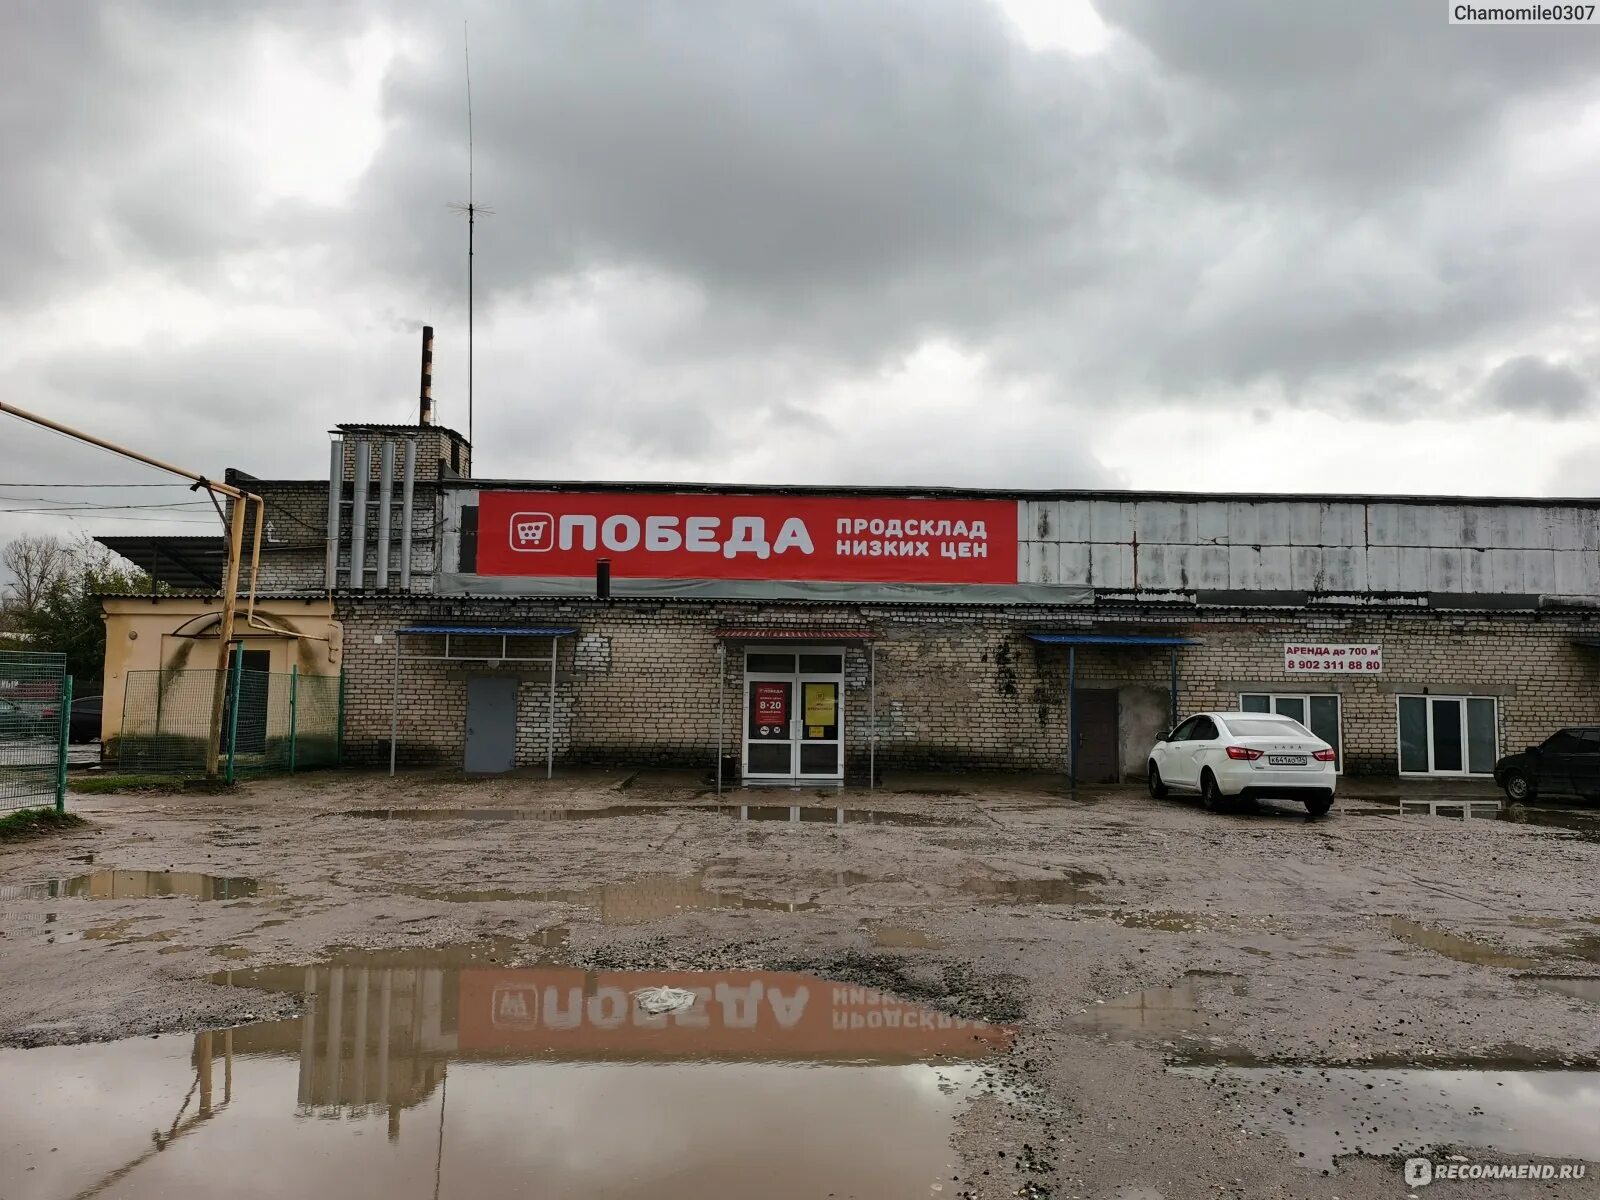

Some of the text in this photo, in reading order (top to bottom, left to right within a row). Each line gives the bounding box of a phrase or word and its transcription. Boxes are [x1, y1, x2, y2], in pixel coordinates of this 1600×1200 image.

[559, 514, 814, 559] ПОБЕДА
[836, 518, 987, 540] ПРОДСКЛАД
[836, 539, 988, 560] НИЗКИХ ЦЕН
[1286, 646, 1330, 656] АРЕНДА
[1332, 648, 1346, 656] до
[1348, 647, 1368, 656] 700
[1287, 660, 1380, 670] 8 902 311 88 80
